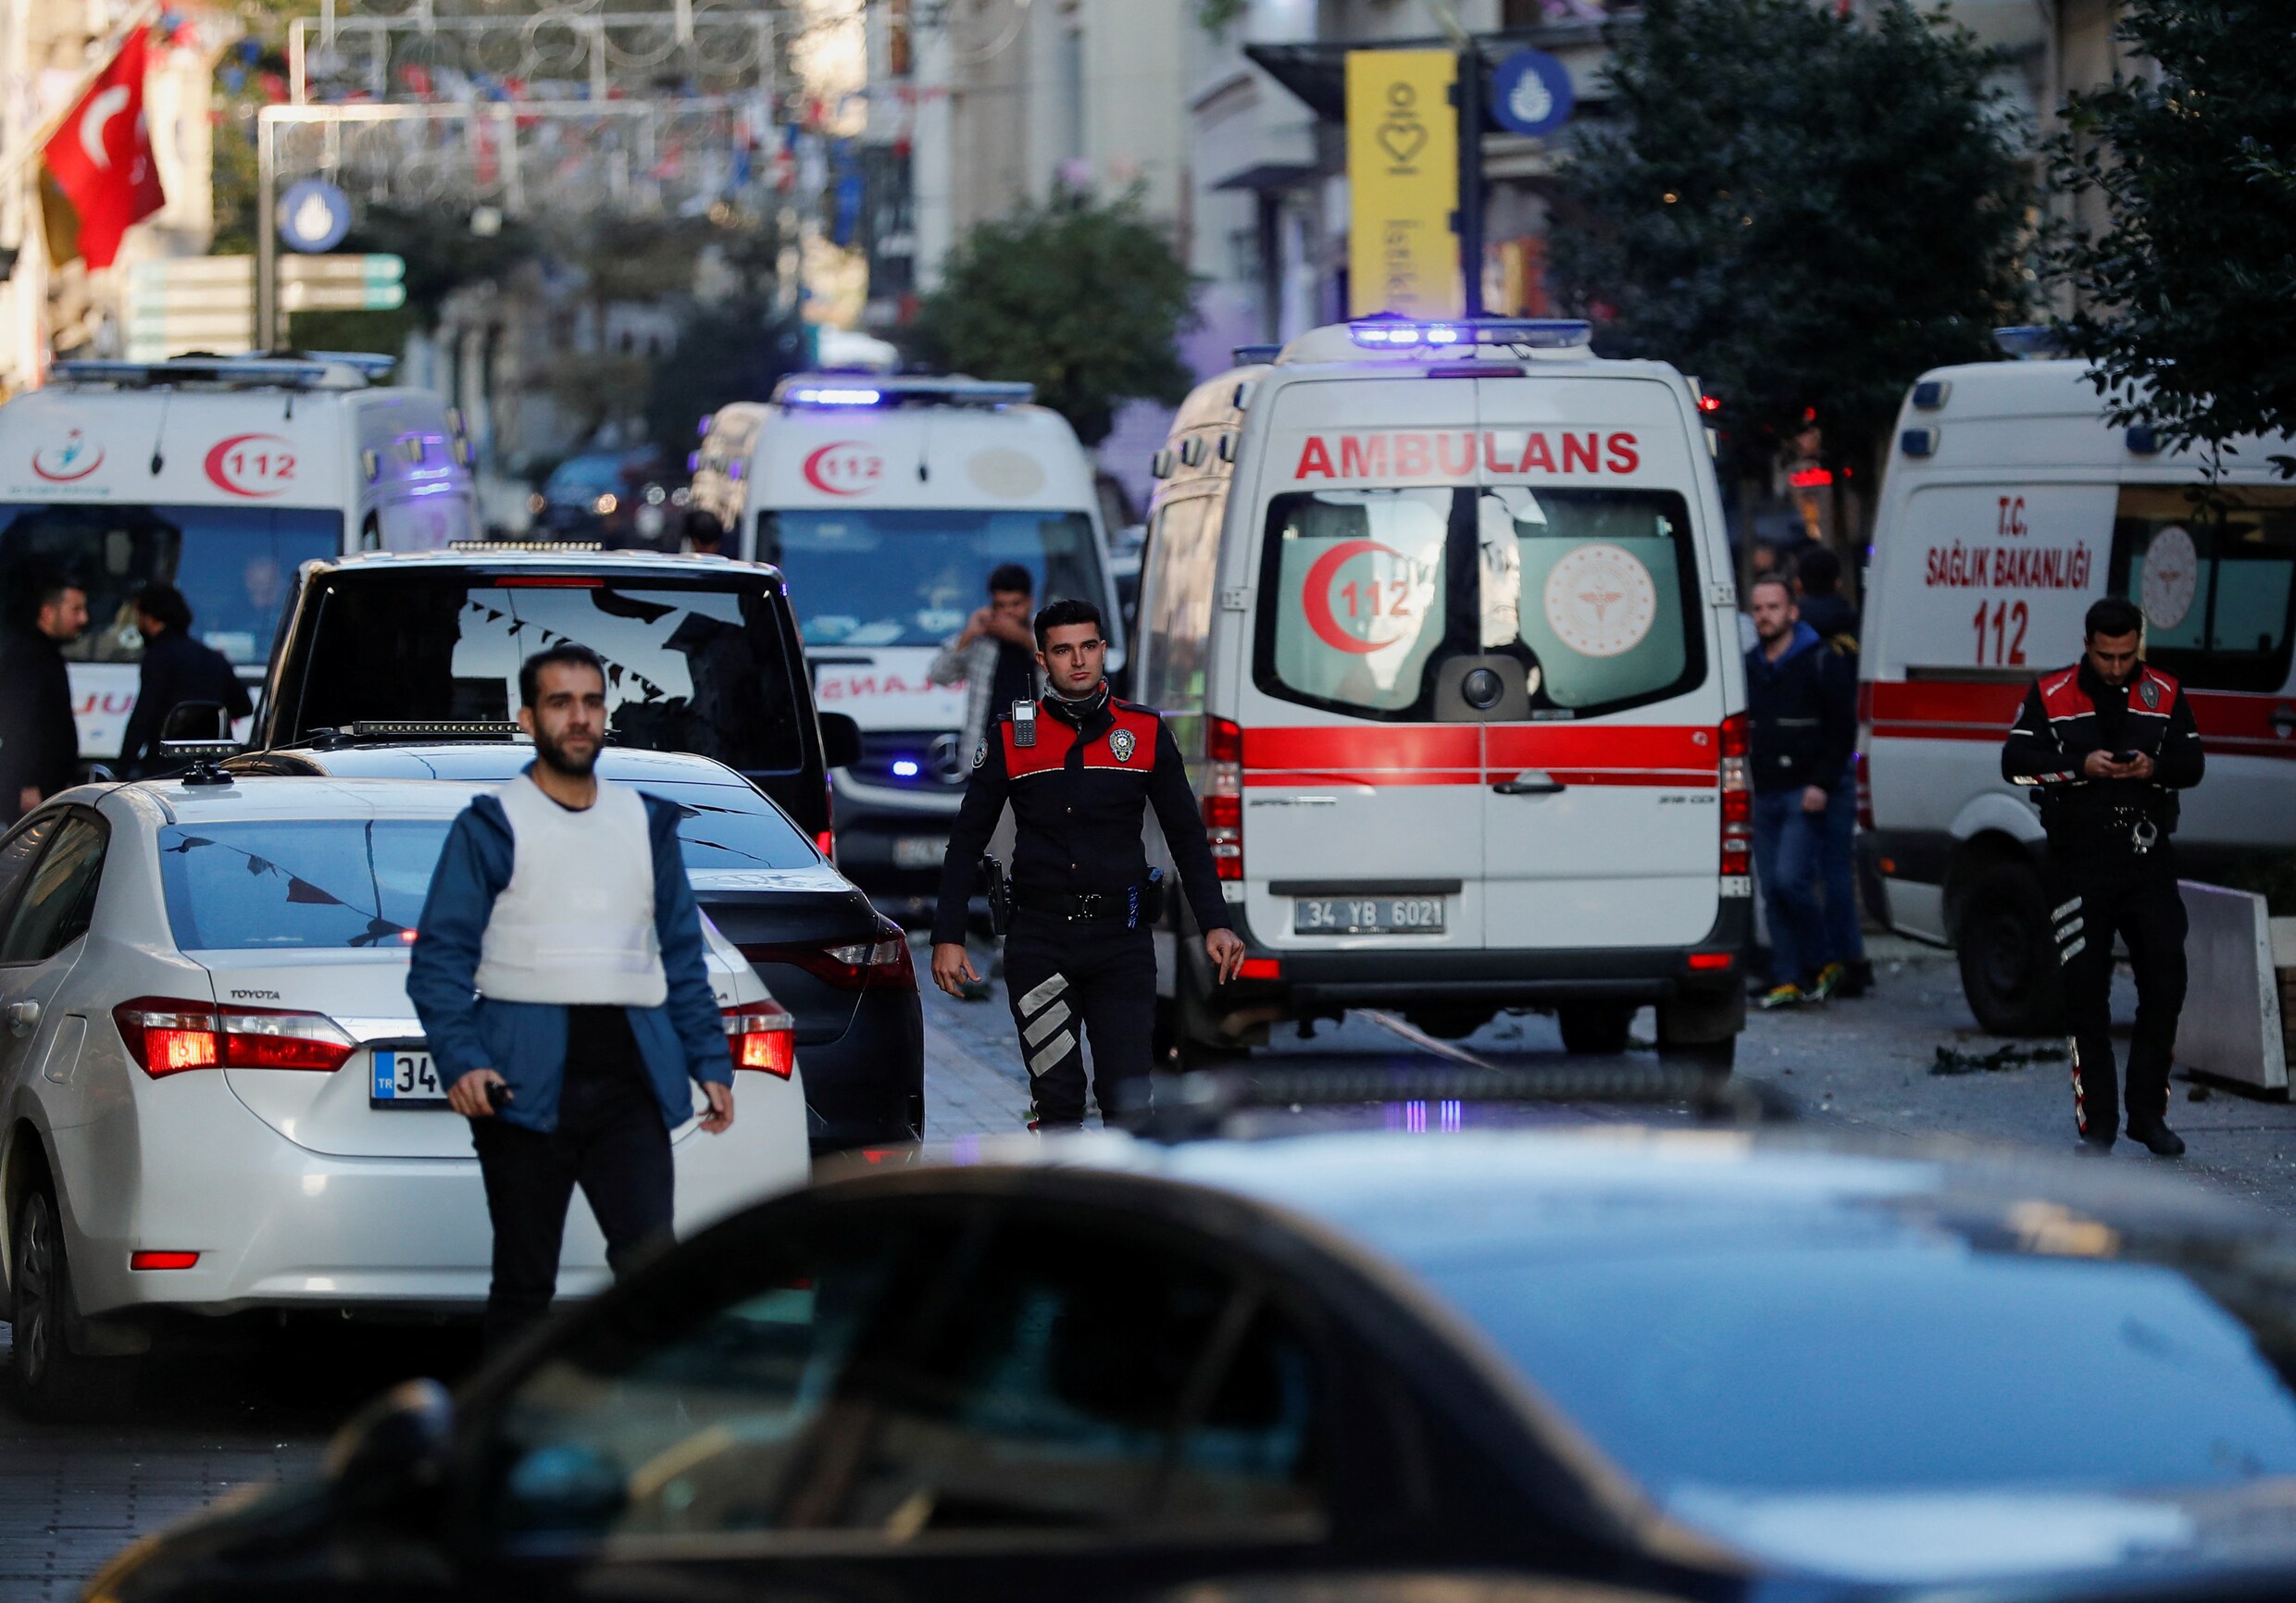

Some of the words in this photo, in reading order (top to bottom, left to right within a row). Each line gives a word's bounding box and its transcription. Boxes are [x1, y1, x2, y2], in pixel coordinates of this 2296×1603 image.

[231, 454, 296, 479] 112
[826, 457, 883, 478] 112
[1293, 431, 1641, 479] AMBULANS
[1997, 494, 2028, 536] T.C.
[1926, 537, 1990, 586] SAĞLIK
[1993, 538, 2092, 590] BAKANLIĞI
[1341, 579, 1410, 617] 112
[1973, 599, 2028, 666] 112
[1307, 901, 1336, 927] 34
[1348, 901, 1378, 926] YB
[1391, 901, 1443, 926] 6021
[230, 989, 281, 1000] TOYOTA
[378, 1077, 393, 1089] TR
[396, 1057, 436, 1094] 34
